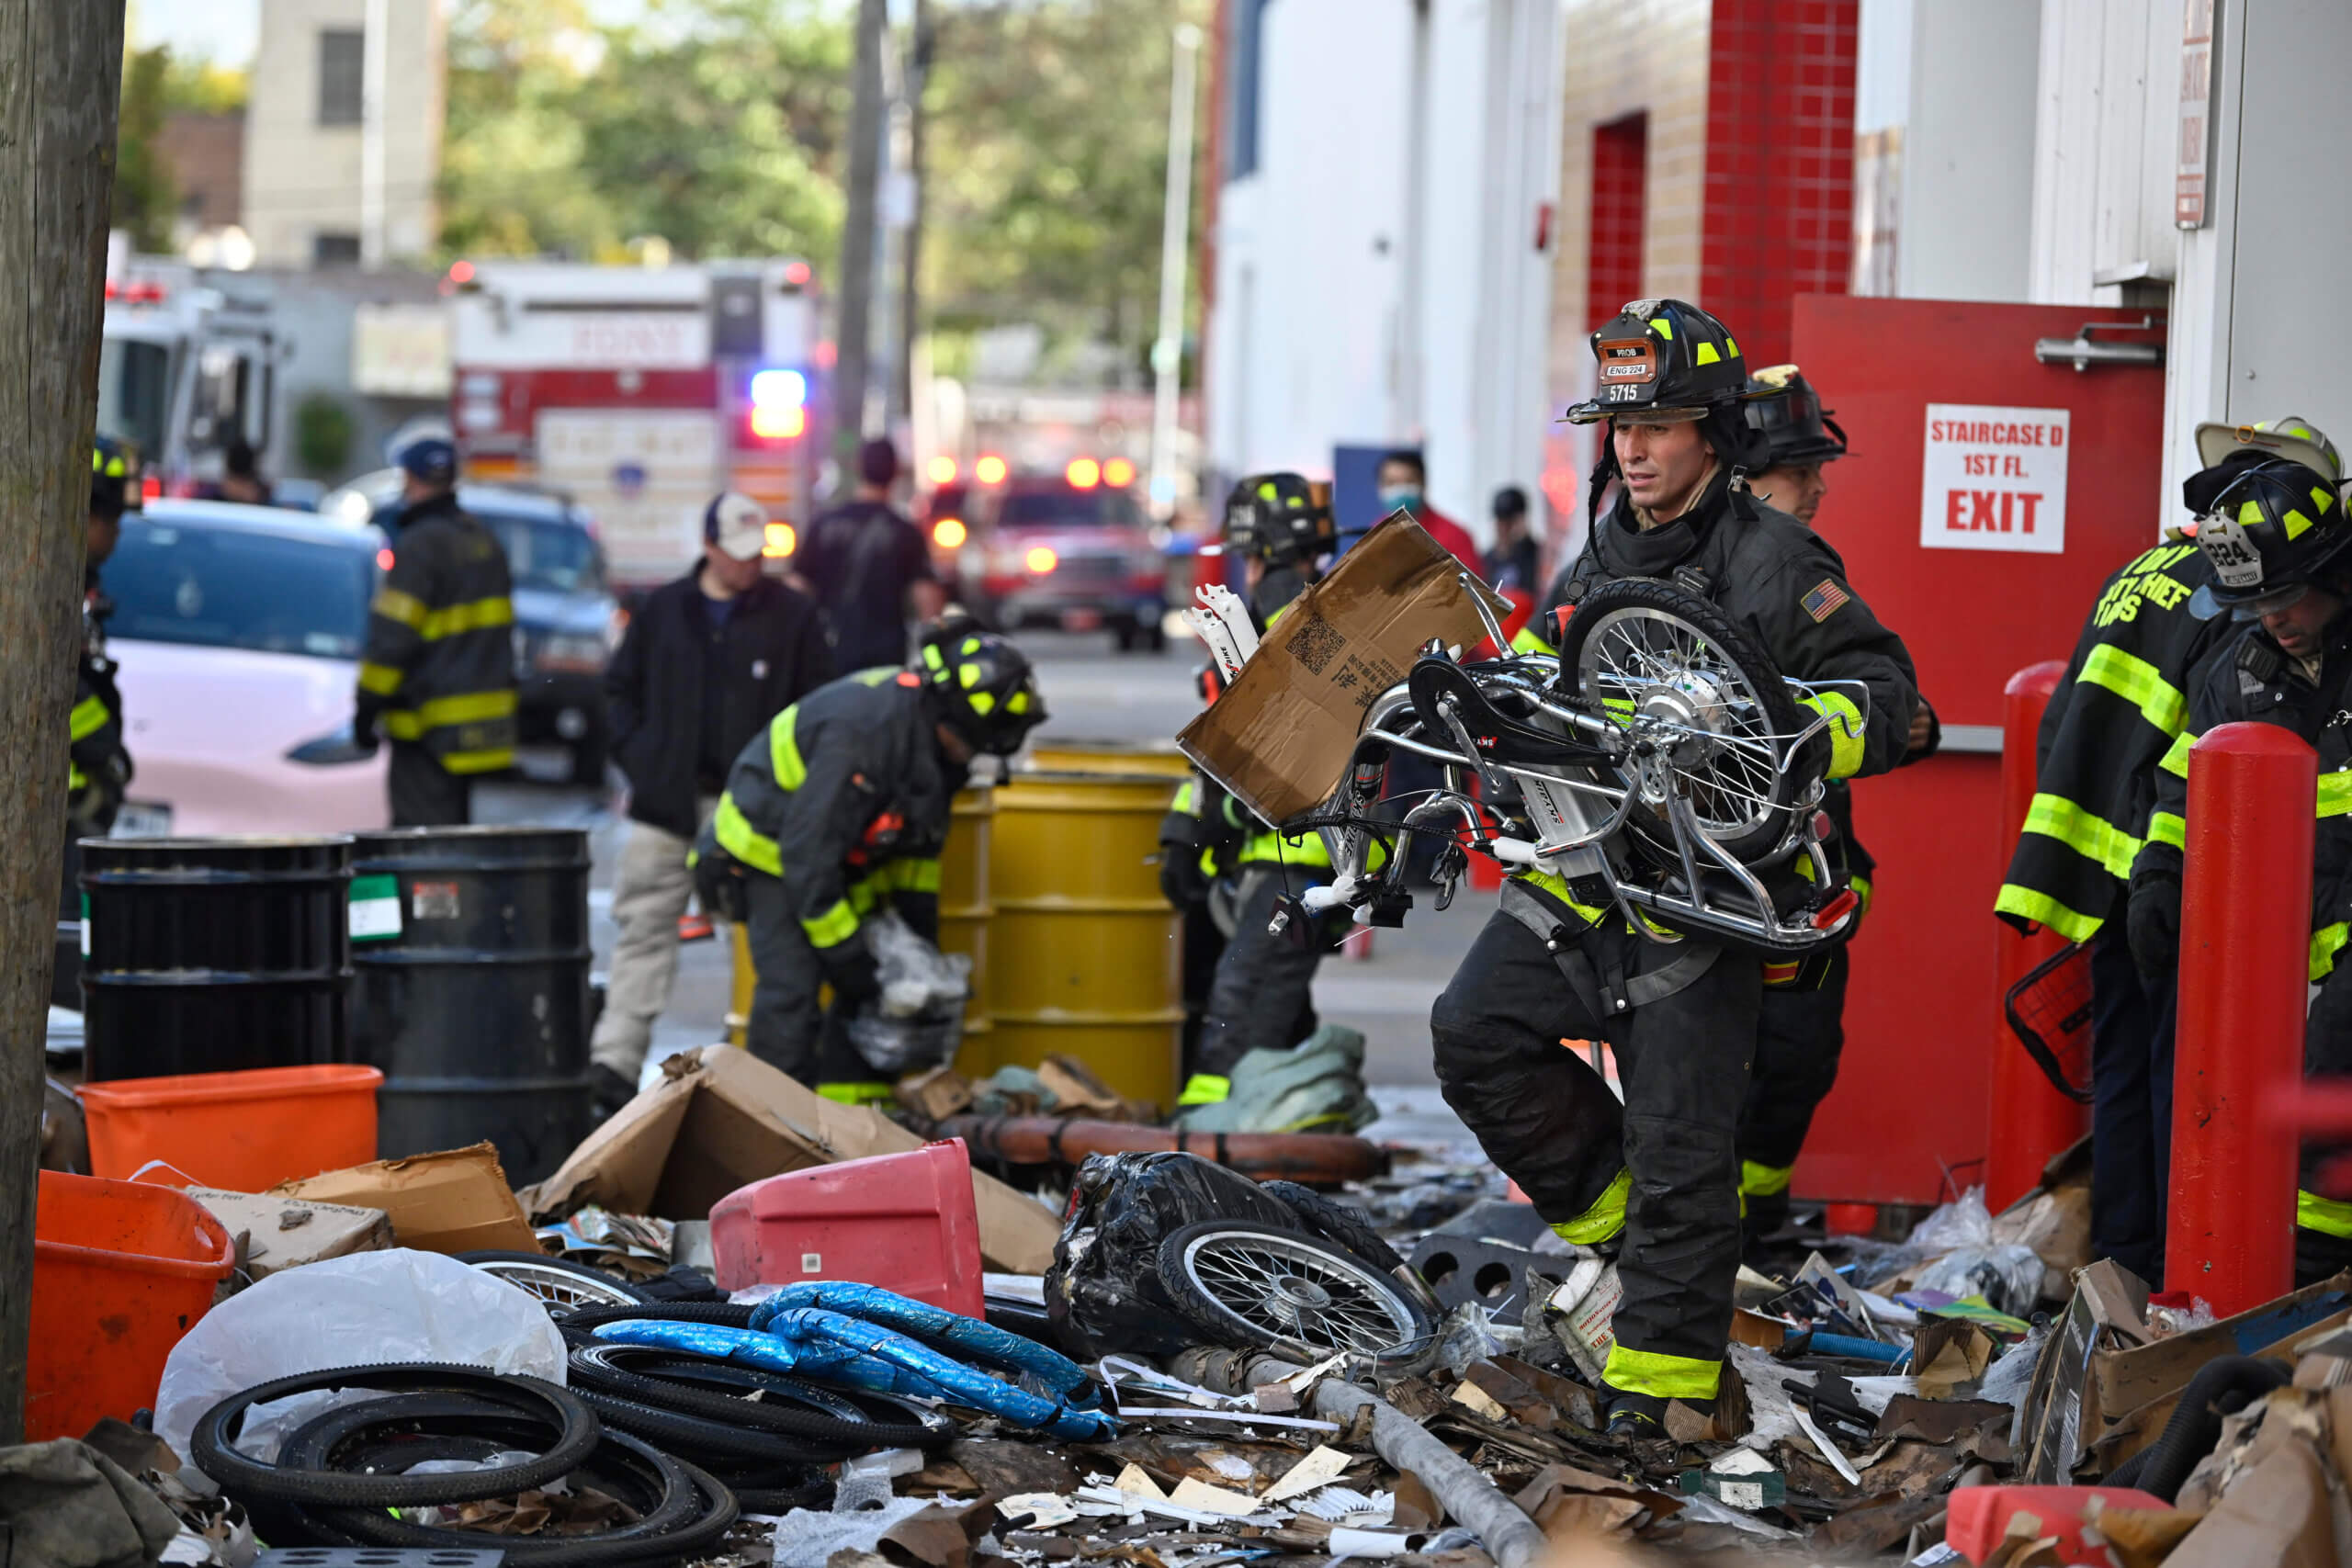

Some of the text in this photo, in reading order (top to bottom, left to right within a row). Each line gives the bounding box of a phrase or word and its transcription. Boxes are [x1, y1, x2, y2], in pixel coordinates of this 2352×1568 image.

[1610, 366, 1643, 375] ENG 224
[1610, 384, 1638, 401] 5715
[1932, 421, 2064, 446] STAIRCASE D
[1964, 454, 2029, 478] 1ST FL.
[1946, 490, 2043, 534] EXIT
